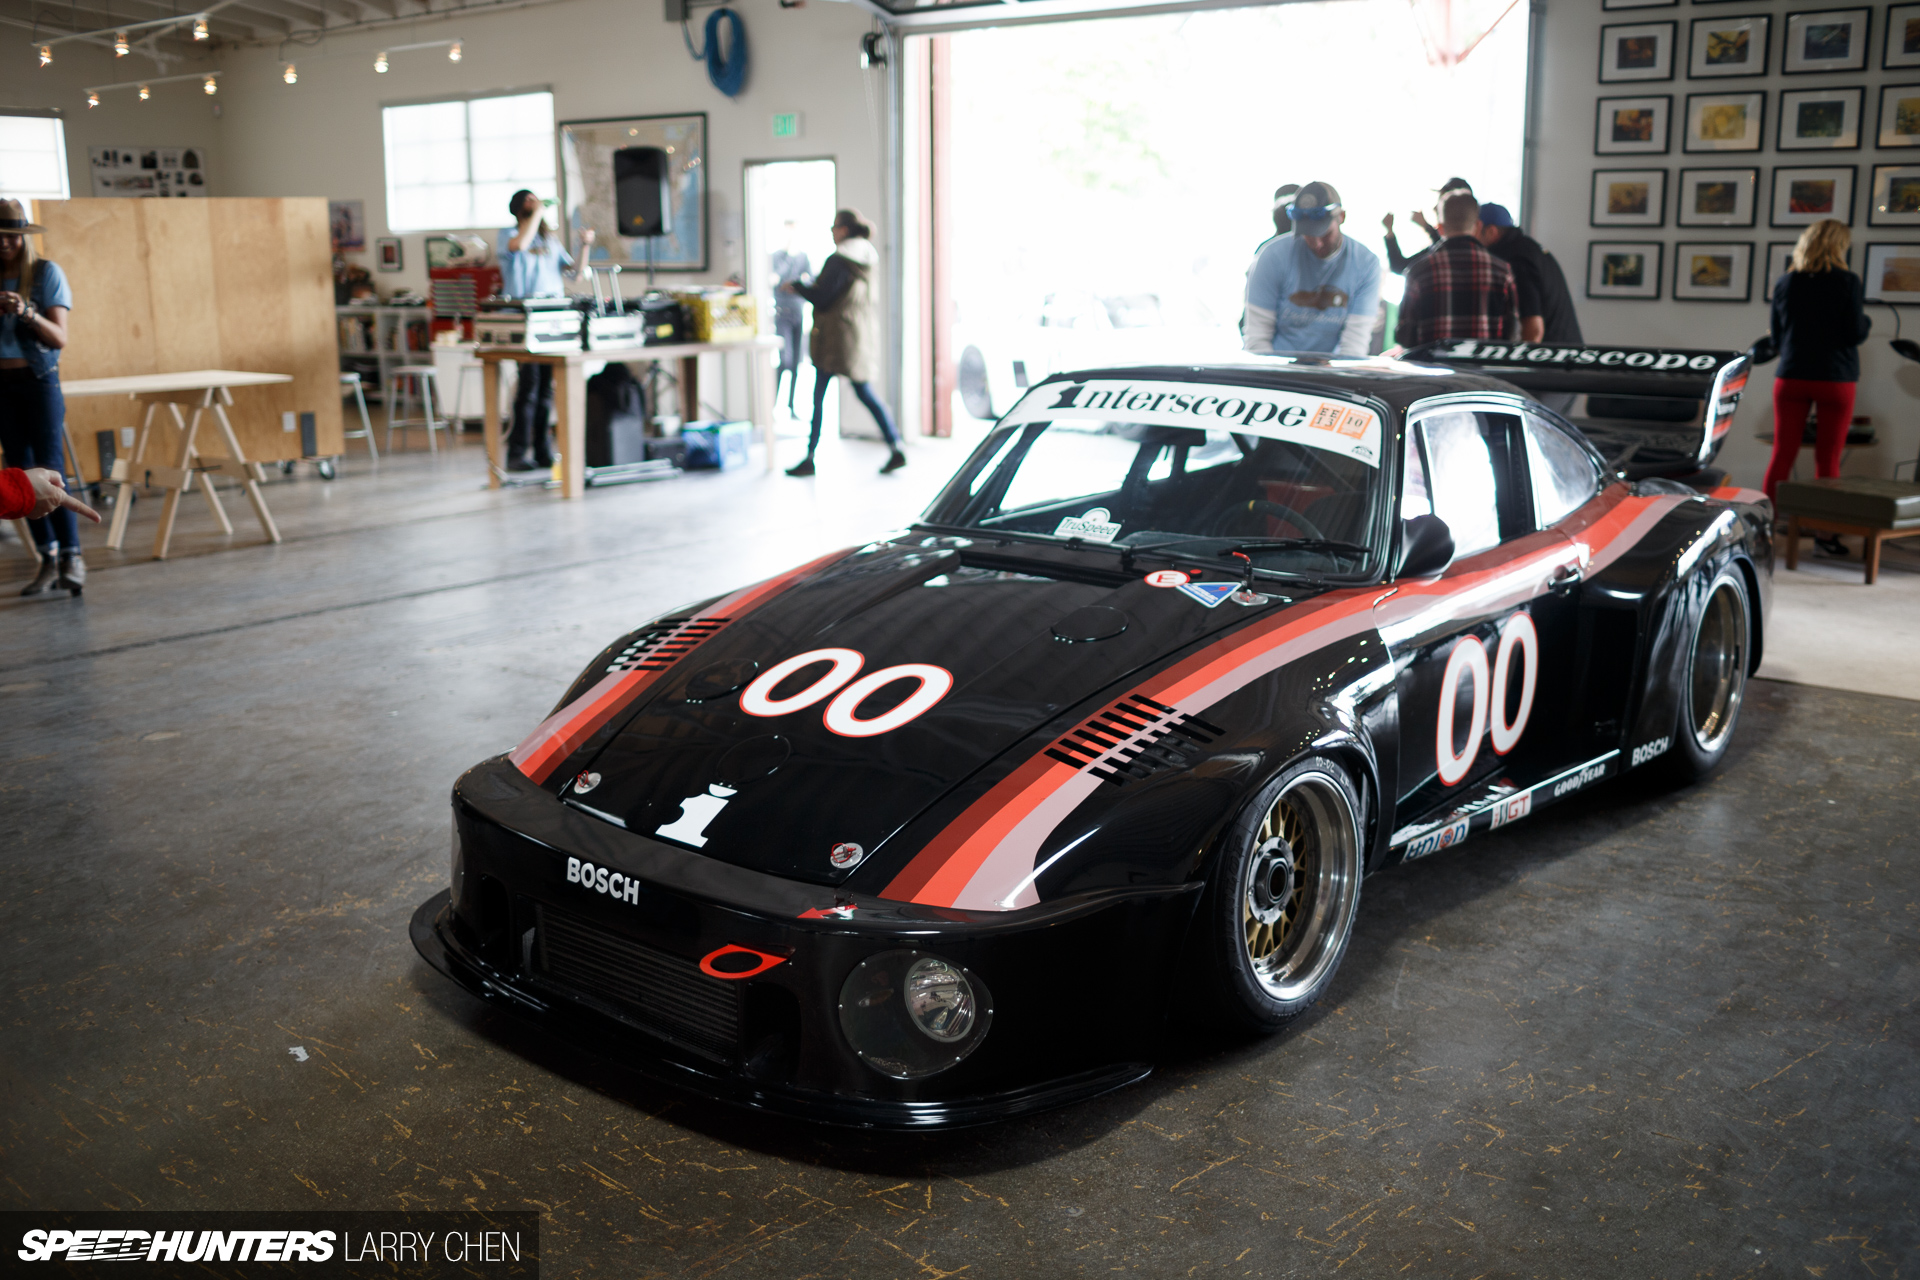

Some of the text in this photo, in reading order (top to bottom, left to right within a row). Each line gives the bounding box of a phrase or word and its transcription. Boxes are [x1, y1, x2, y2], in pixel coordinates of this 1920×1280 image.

[1061, 519, 1119, 535] TruSpeed
[739, 647, 954, 738] 00
[1436, 611, 1538, 787] 00
[1632, 736, 1669, 767] BOSCH
[566, 856, 640, 905] BOSCH
